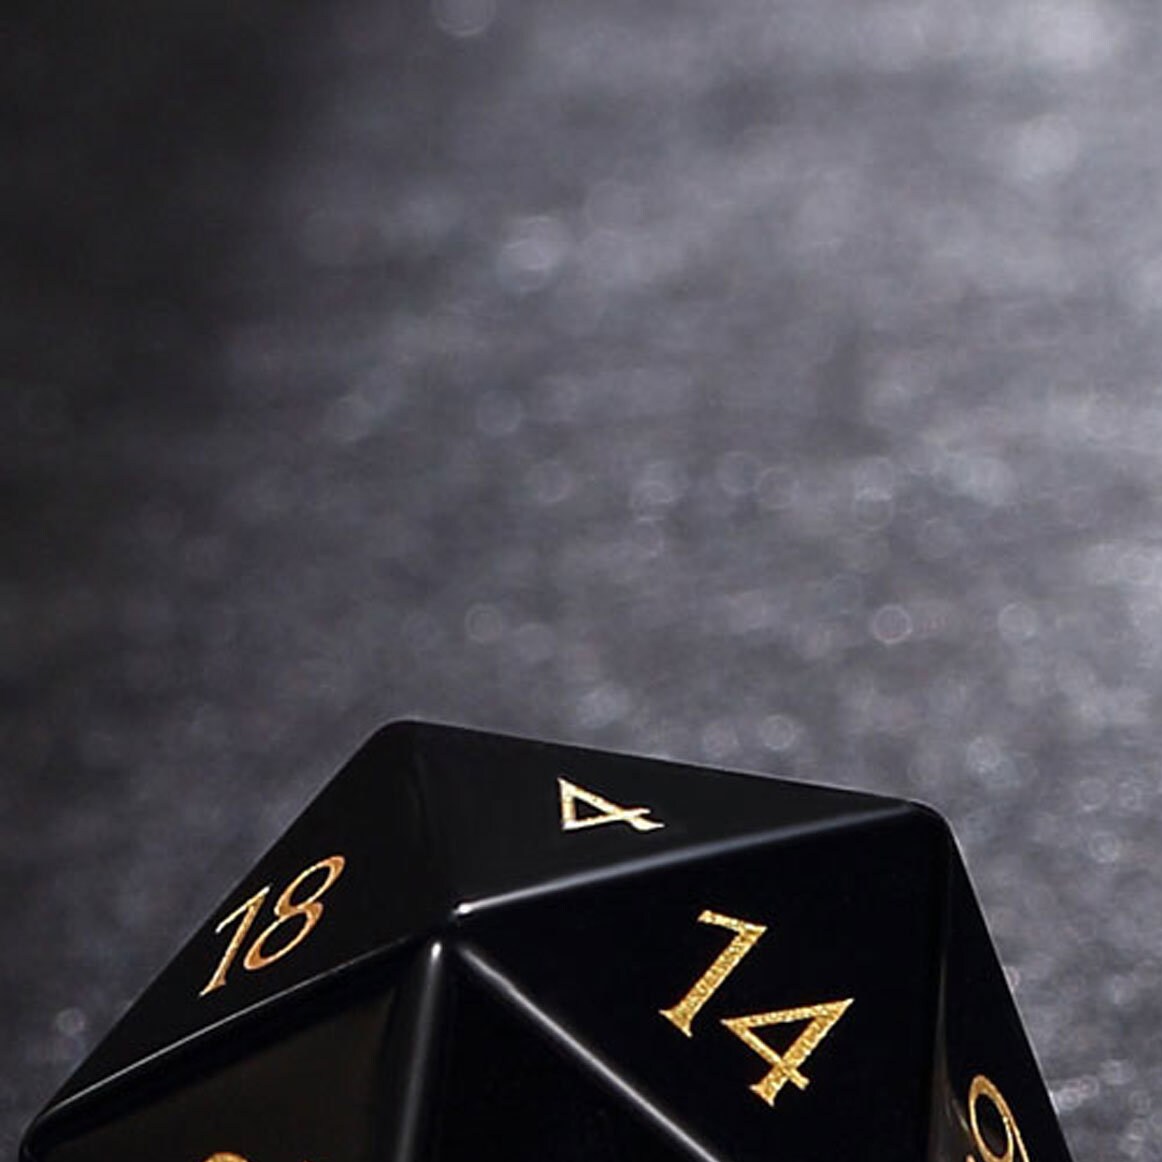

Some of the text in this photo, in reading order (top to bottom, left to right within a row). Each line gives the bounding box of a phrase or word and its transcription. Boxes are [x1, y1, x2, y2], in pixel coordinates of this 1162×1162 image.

[558, 777, 665, 832] 4
[200, 855, 346, 997] 18
[658, 909, 856, 1107] 14
